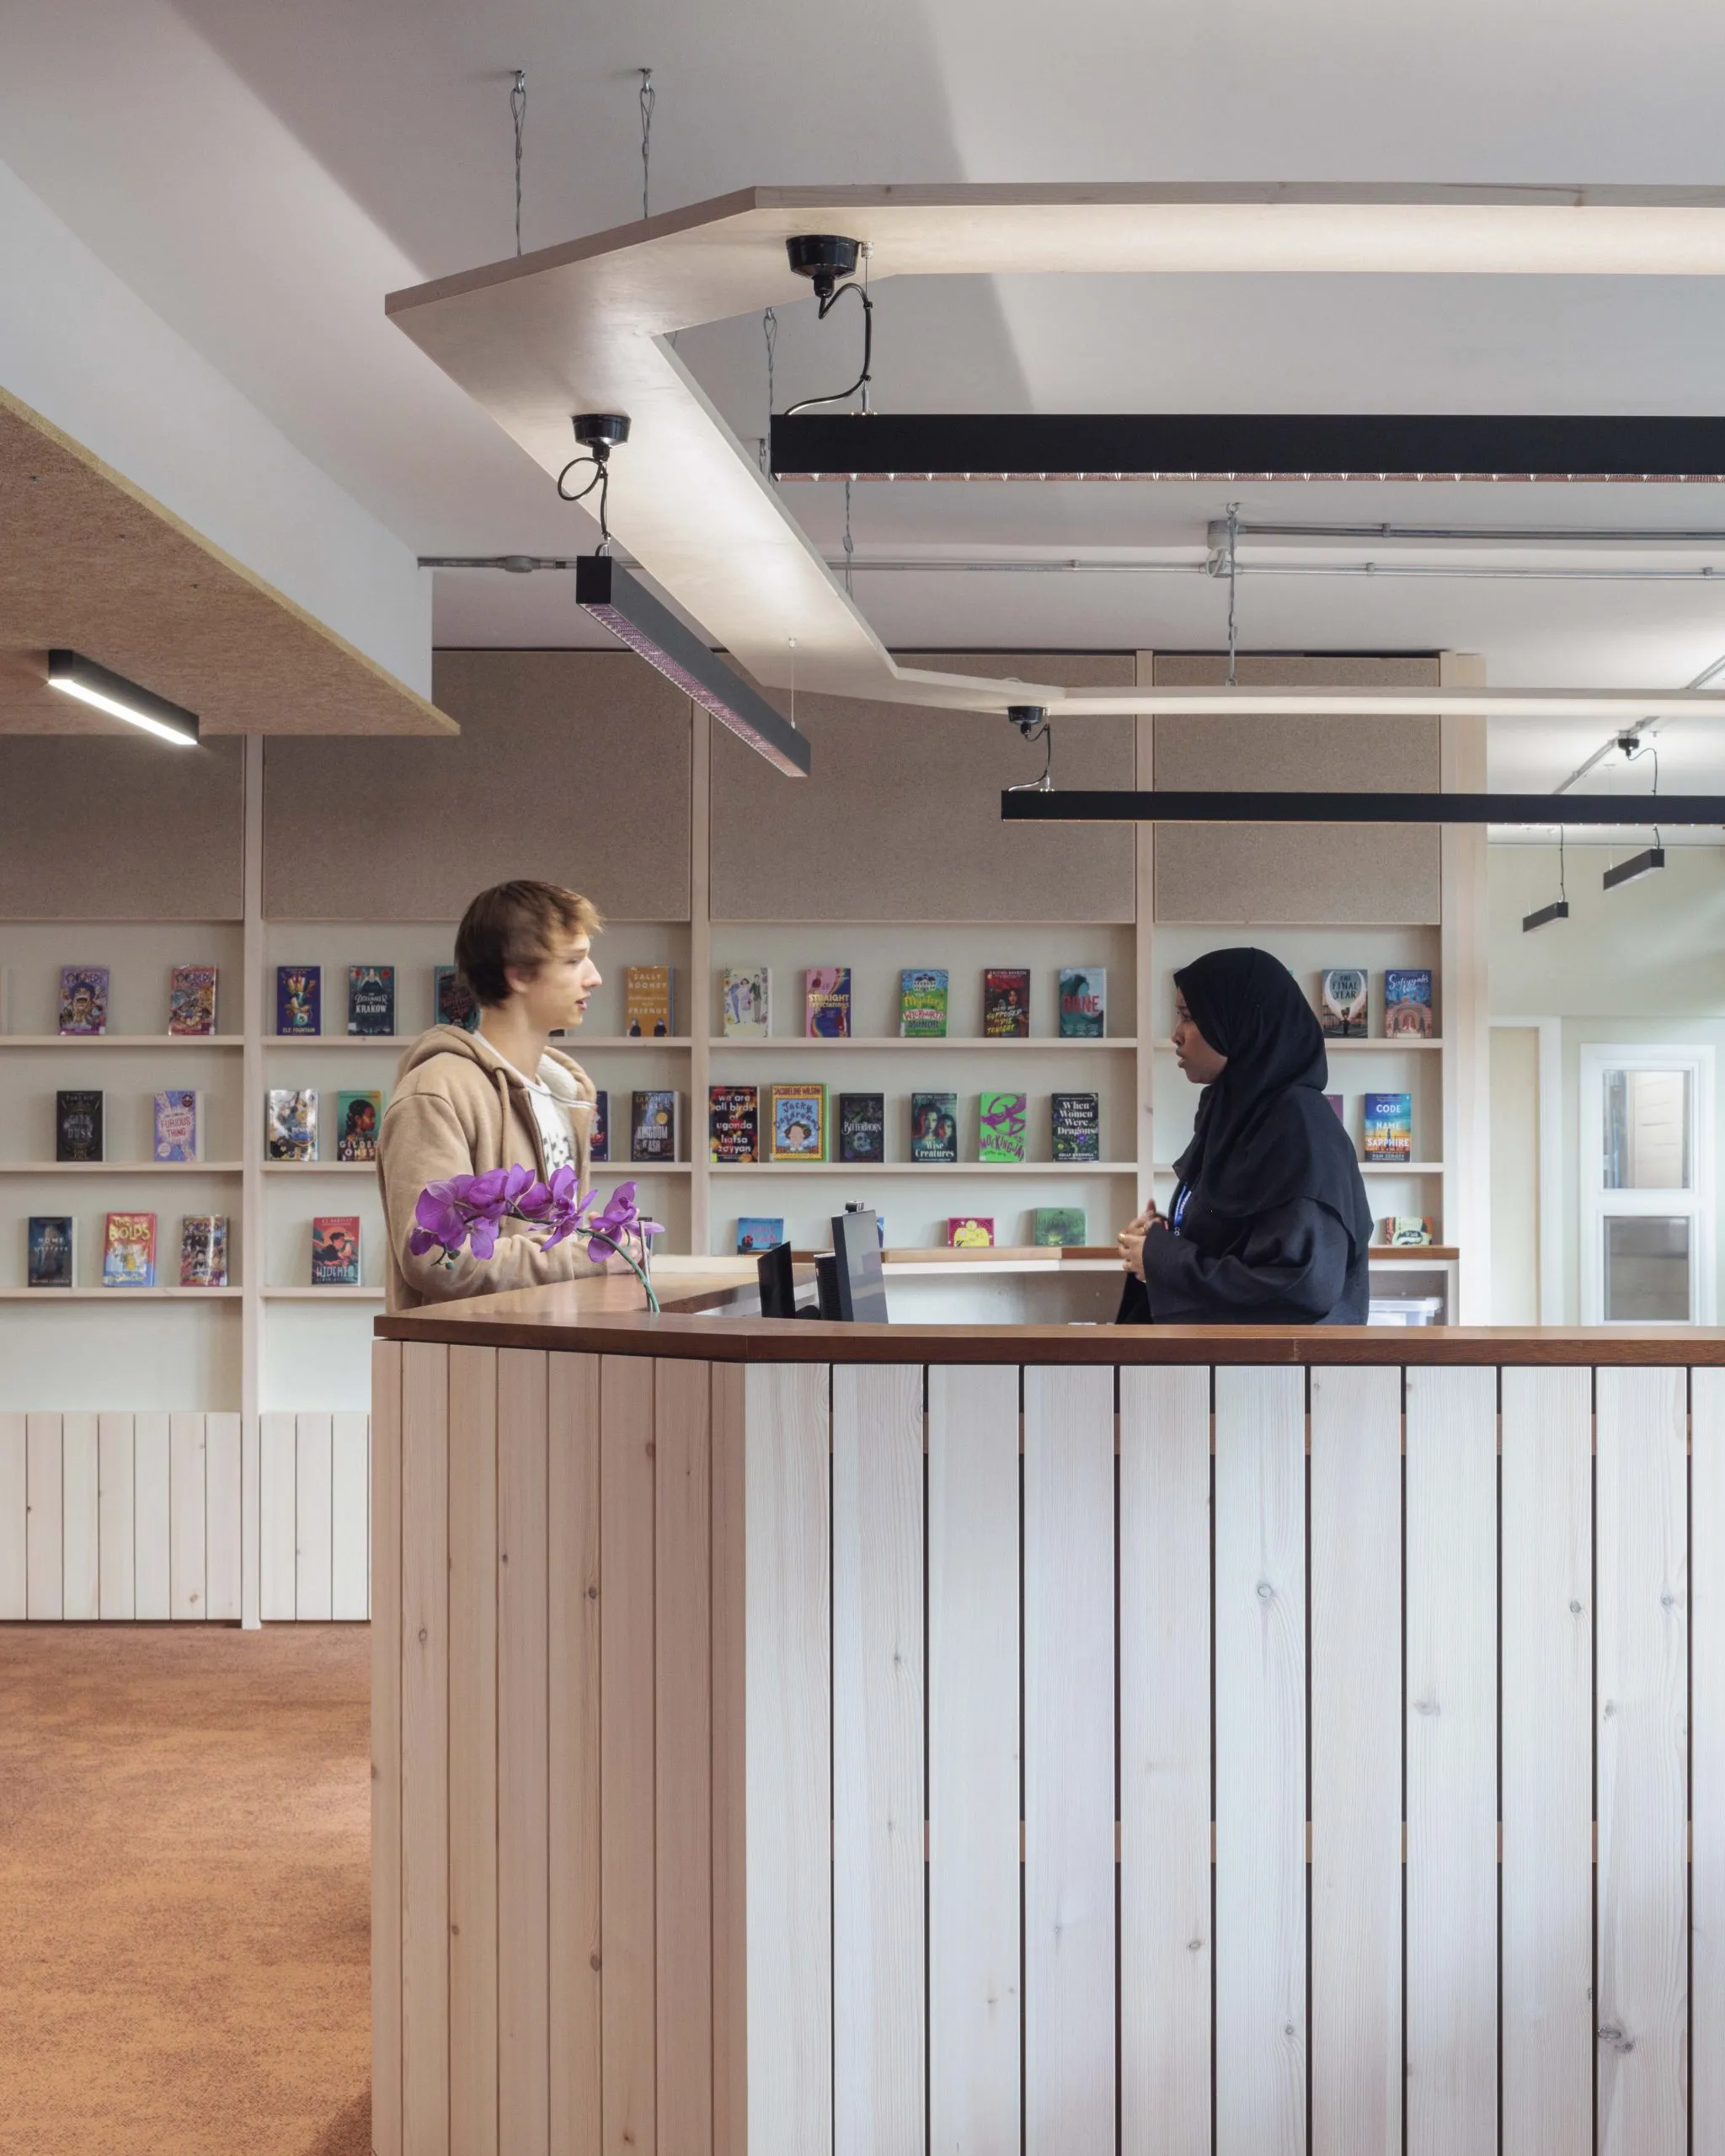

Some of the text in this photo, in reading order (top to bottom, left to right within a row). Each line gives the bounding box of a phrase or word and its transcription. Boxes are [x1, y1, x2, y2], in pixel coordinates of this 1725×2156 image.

[1332, 982, 1358, 990] FINAL
[715, 1102, 754, 1112] all birds
[1062, 1101, 1089, 1110] When
[1376, 1104, 1402, 1113] CODE
[1060, 1110, 1093, 1118] Women
[717, 1121, 752, 1130] uganda
[1064, 1118, 1087, 1127] Were
[168, 1129, 186, 1138] THING
[1057, 1127, 1097, 1136] Dragons
[721, 1134, 748, 1144] hafsa
[1367, 1138, 1409, 1147] SAPPHIRE
[718, 1145, 751, 1154] zayyan
[916, 1150, 954, 1158] Creatures
[109, 1224, 151, 1241] BOLDS
[745, 1234, 777, 1244] RYAN
